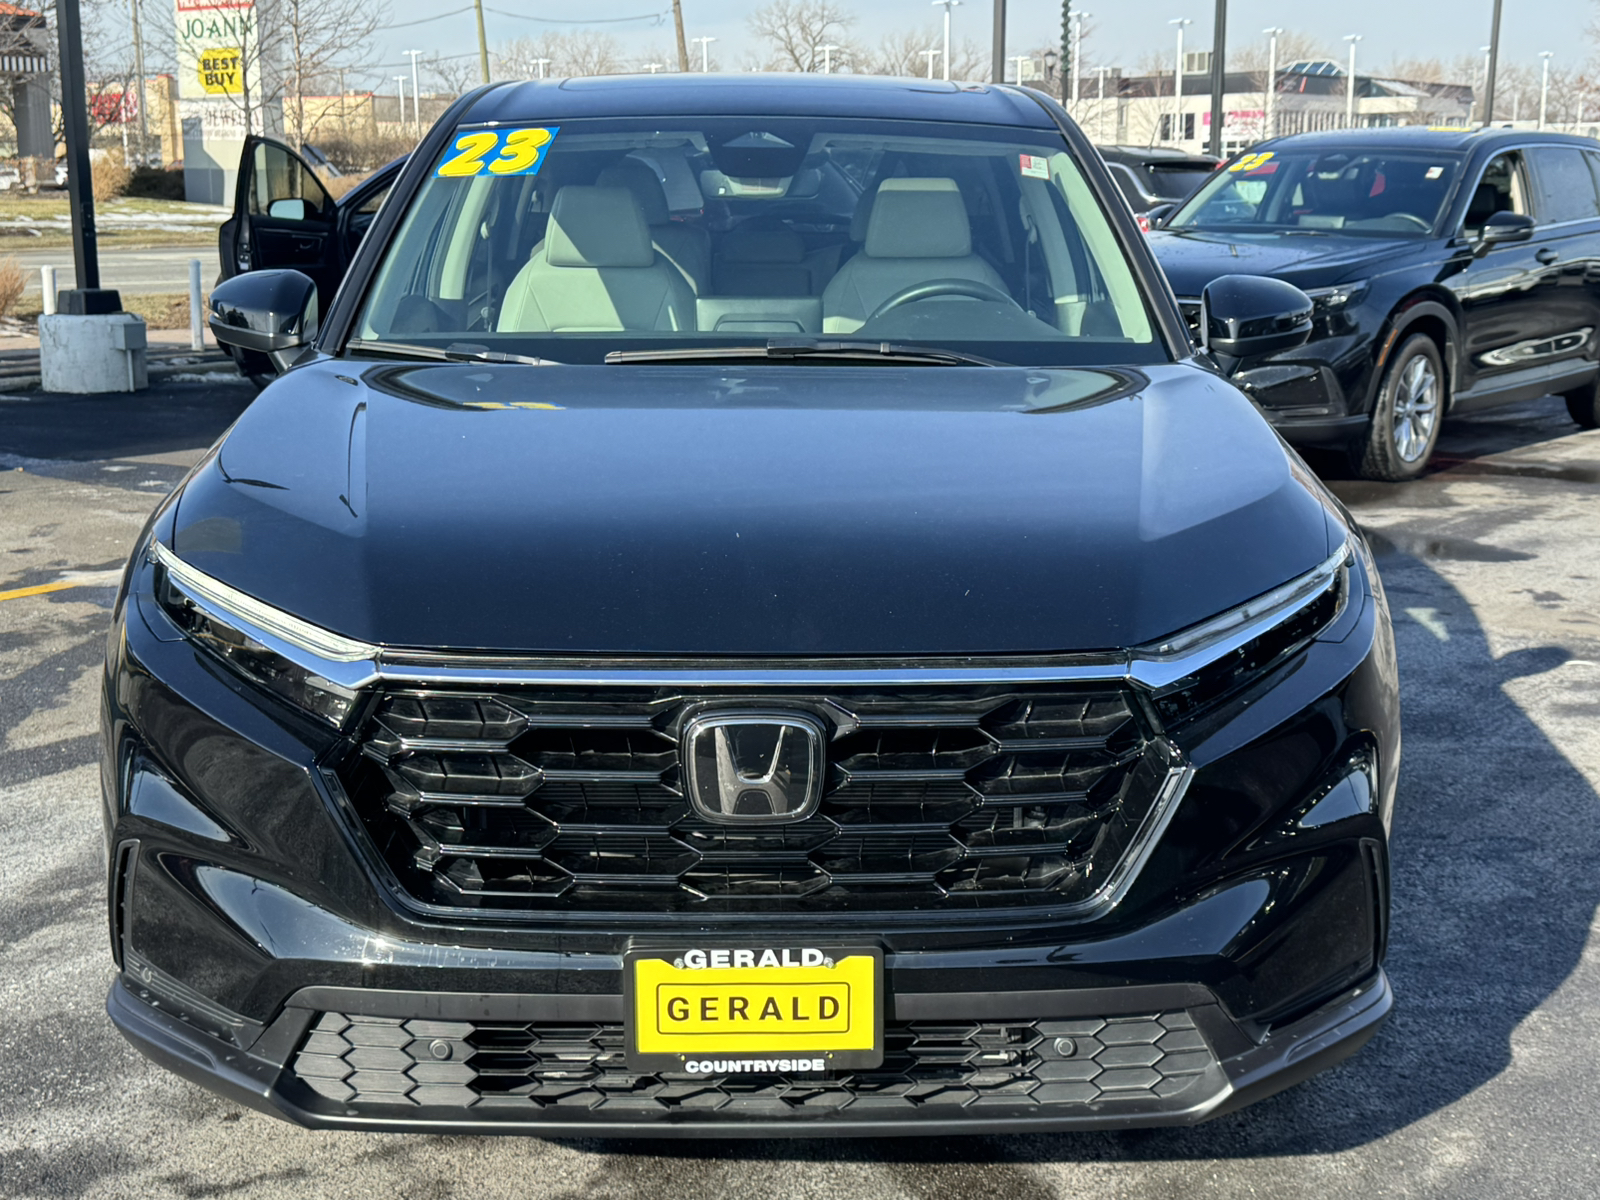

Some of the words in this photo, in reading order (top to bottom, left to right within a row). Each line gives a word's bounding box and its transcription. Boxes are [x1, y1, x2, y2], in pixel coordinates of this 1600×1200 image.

[203, 57, 239, 70] BEST
[205, 72, 235, 86] BUY
[438, 128, 552, 176] 23
[684, 948, 825, 969] GERALD
[667, 996, 840, 1022] GERALD
[685, 1059, 825, 1073] COUNTRYSIDE
